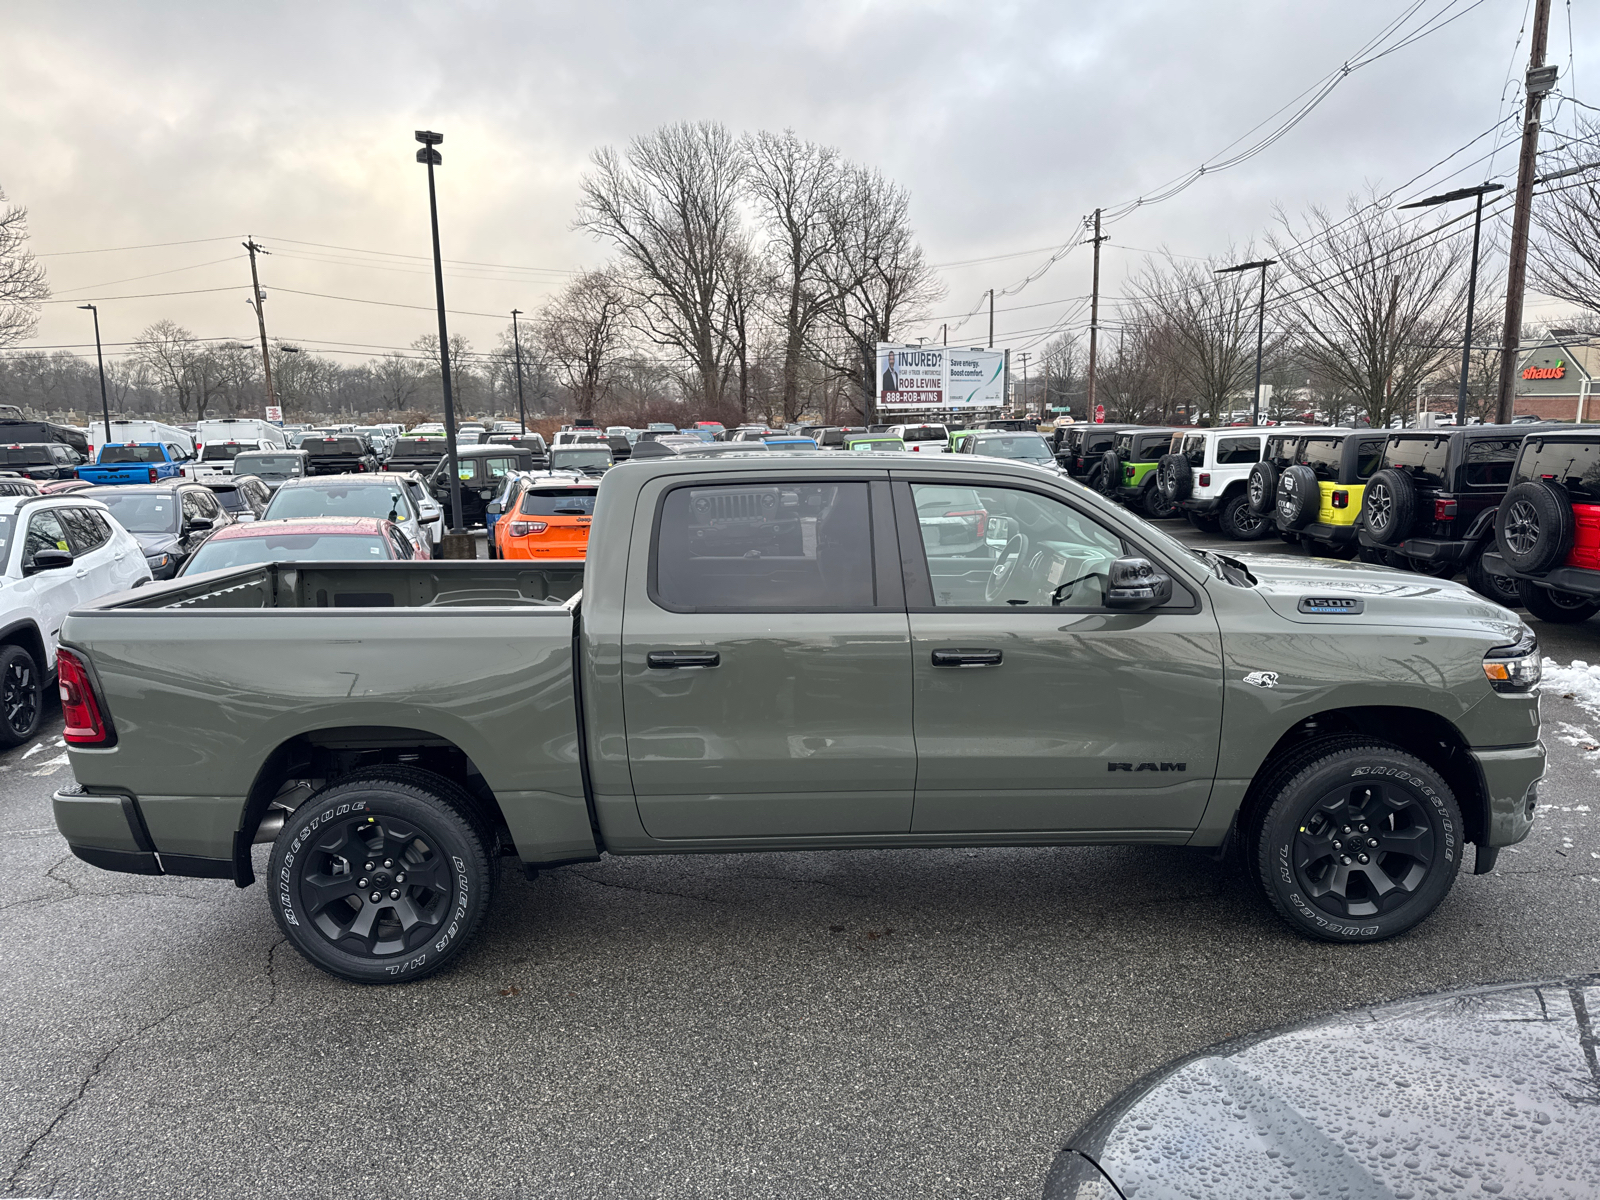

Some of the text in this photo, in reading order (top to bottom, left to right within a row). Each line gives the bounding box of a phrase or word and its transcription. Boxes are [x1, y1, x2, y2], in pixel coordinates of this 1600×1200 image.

[898, 352, 942, 367] INJURED?
[962, 360, 980, 368] energy.
[899, 378, 942, 388] ROB LEVINE
[886, 392, 938, 402] 888-ROB-WINS
[1305, 598, 1356, 607] 1500
[1108, 762, 1186, 772] RAM
[1352, 766, 1454, 862] BRIDGESTONE
[280, 800, 366, 926] BRIDGESTONE
[435, 855, 468, 952] DUELER
[1290, 894, 1379, 936] DUELER
[386, 954, 426, 974] H/L
